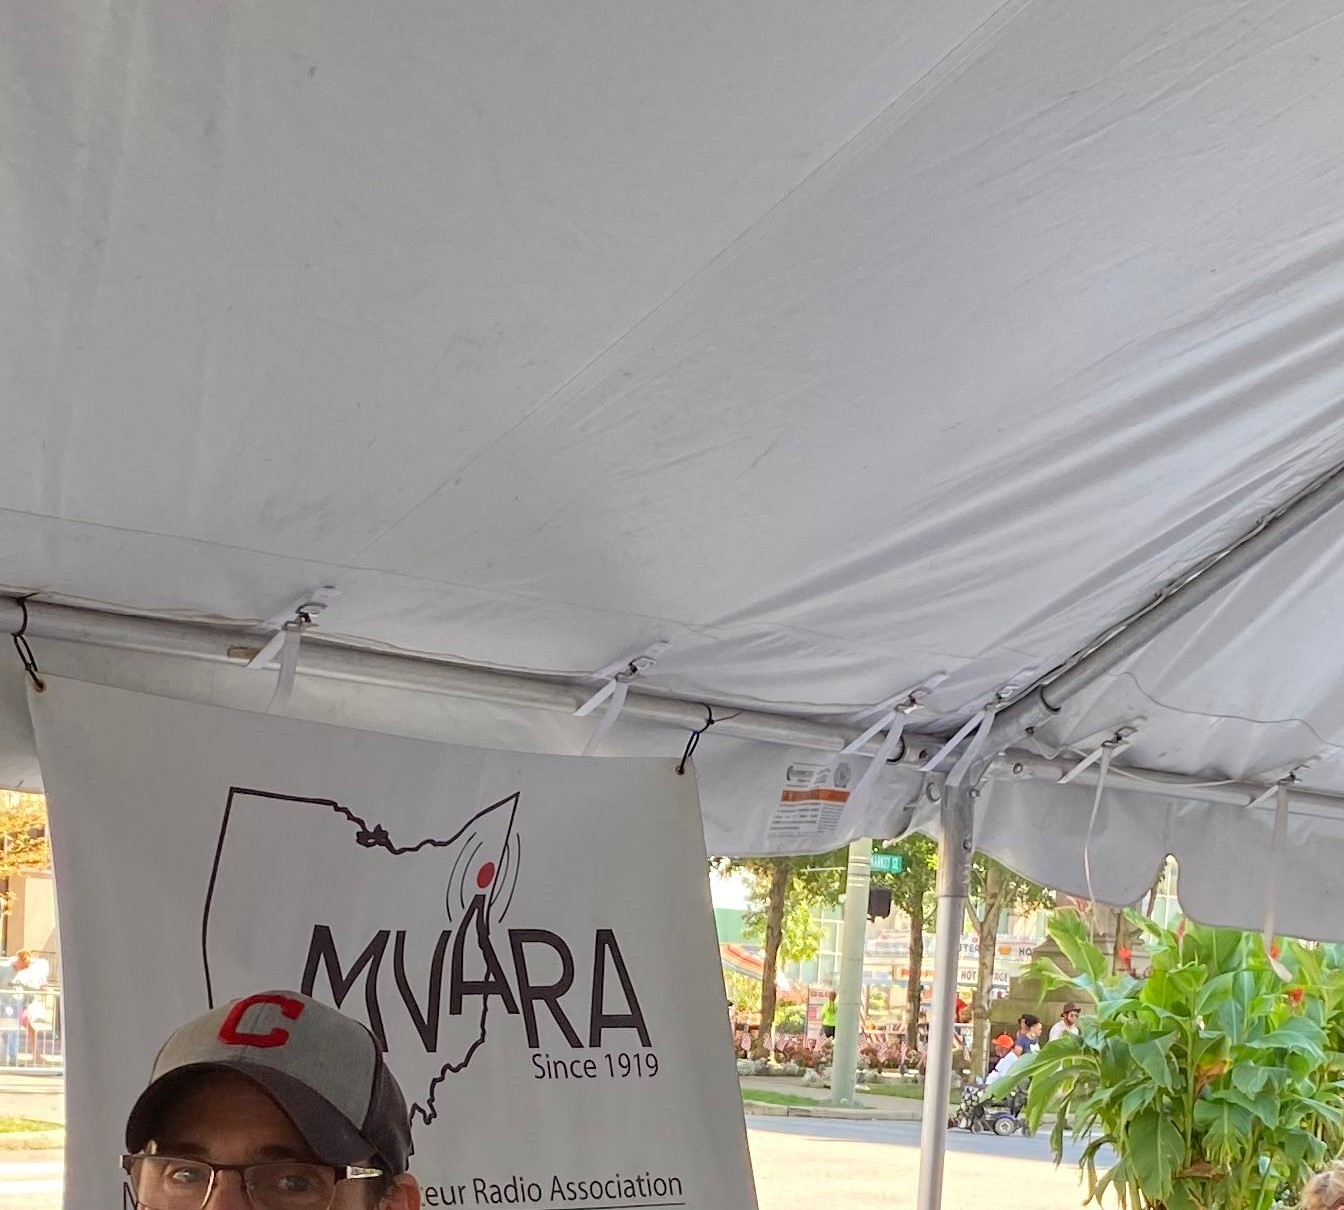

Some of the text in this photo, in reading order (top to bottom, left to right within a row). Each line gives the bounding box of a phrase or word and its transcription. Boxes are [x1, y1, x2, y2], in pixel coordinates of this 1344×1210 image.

[301, 893, 653, 1053] MVARA
[219, 994, 305, 1049] C
[532, 1053, 660, 1080] Since 1919
[422, 1171, 683, 1208] eur Radio Association
